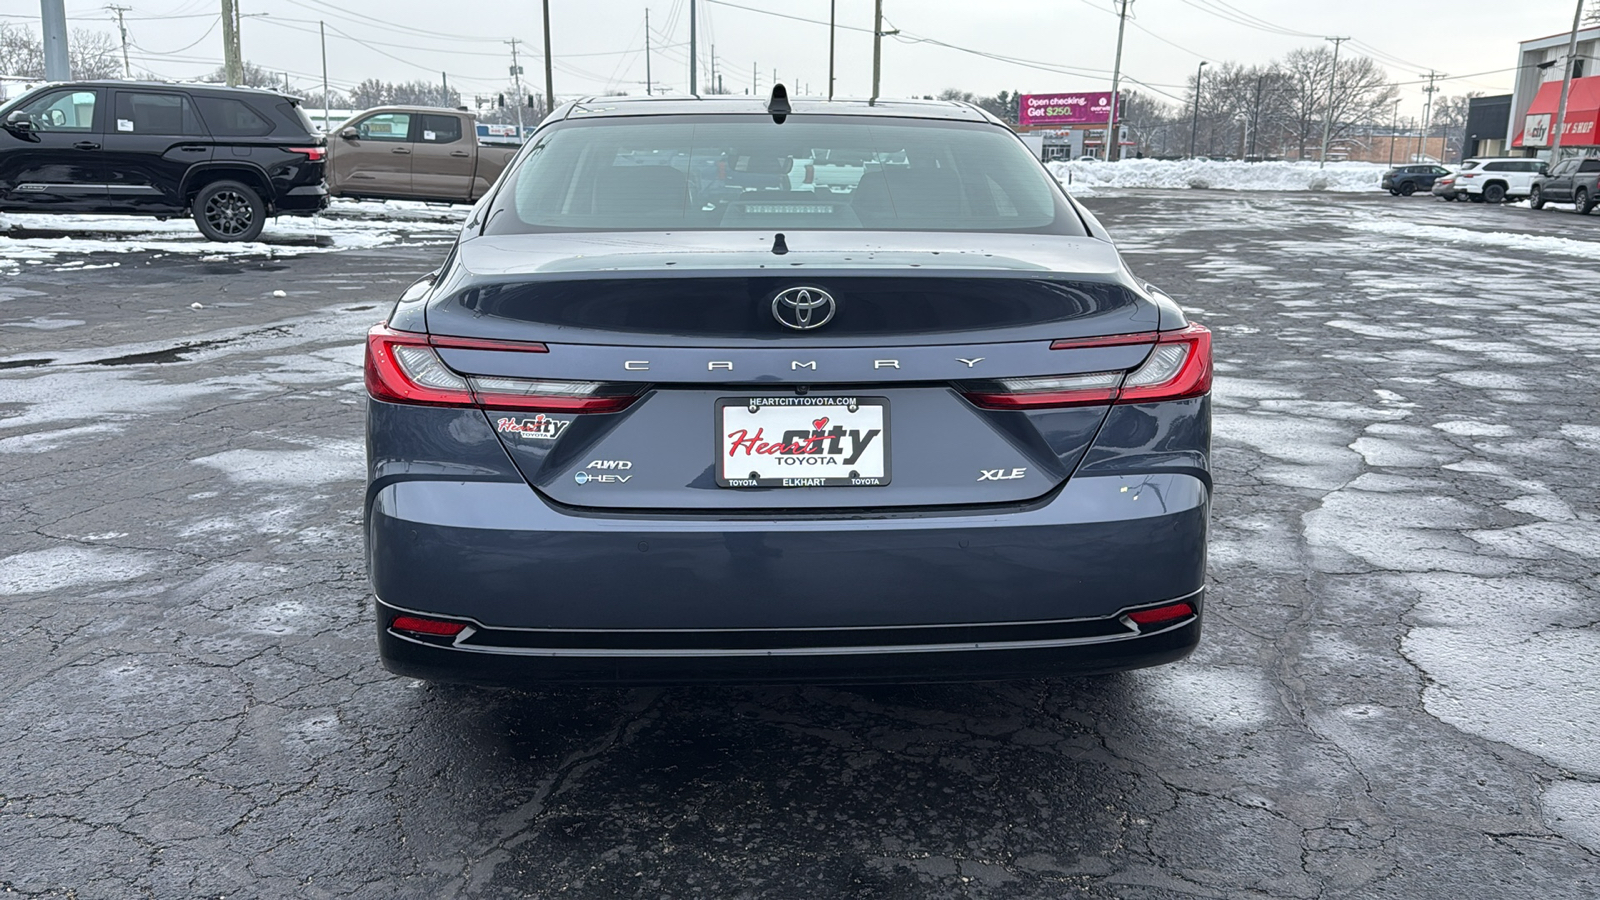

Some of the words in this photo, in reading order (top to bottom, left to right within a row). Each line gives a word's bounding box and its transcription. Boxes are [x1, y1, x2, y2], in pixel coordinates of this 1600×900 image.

[1028, 98, 1049, 107] Open
[1050, 97, 1087, 106] checking.
[1028, 108, 1045, 117] Get
[1046, 106, 1072, 116] $250.
[1550, 123, 1572, 134] BDY
[1571, 121, 1594, 134] SHOP
[624, 357, 985, 372] CAMRY
[750, 397, 856, 406] HEARTCITYTOYOTA.COM
[498, 418, 546, 432] Heart
[522, 417, 567, 438] city
[728, 428, 836, 457] Heart
[780, 422, 881, 465] city
[586, 460, 632, 470] AWD
[775, 456, 837, 466] TOYOTA
[588, 474, 633, 483] HEV
[977, 467, 1027, 482] XLE
[728, 479, 758, 487] TOYOTA
[782, 478, 826, 487] ELKHART
[851, 478, 880, 486] TOYOTA
